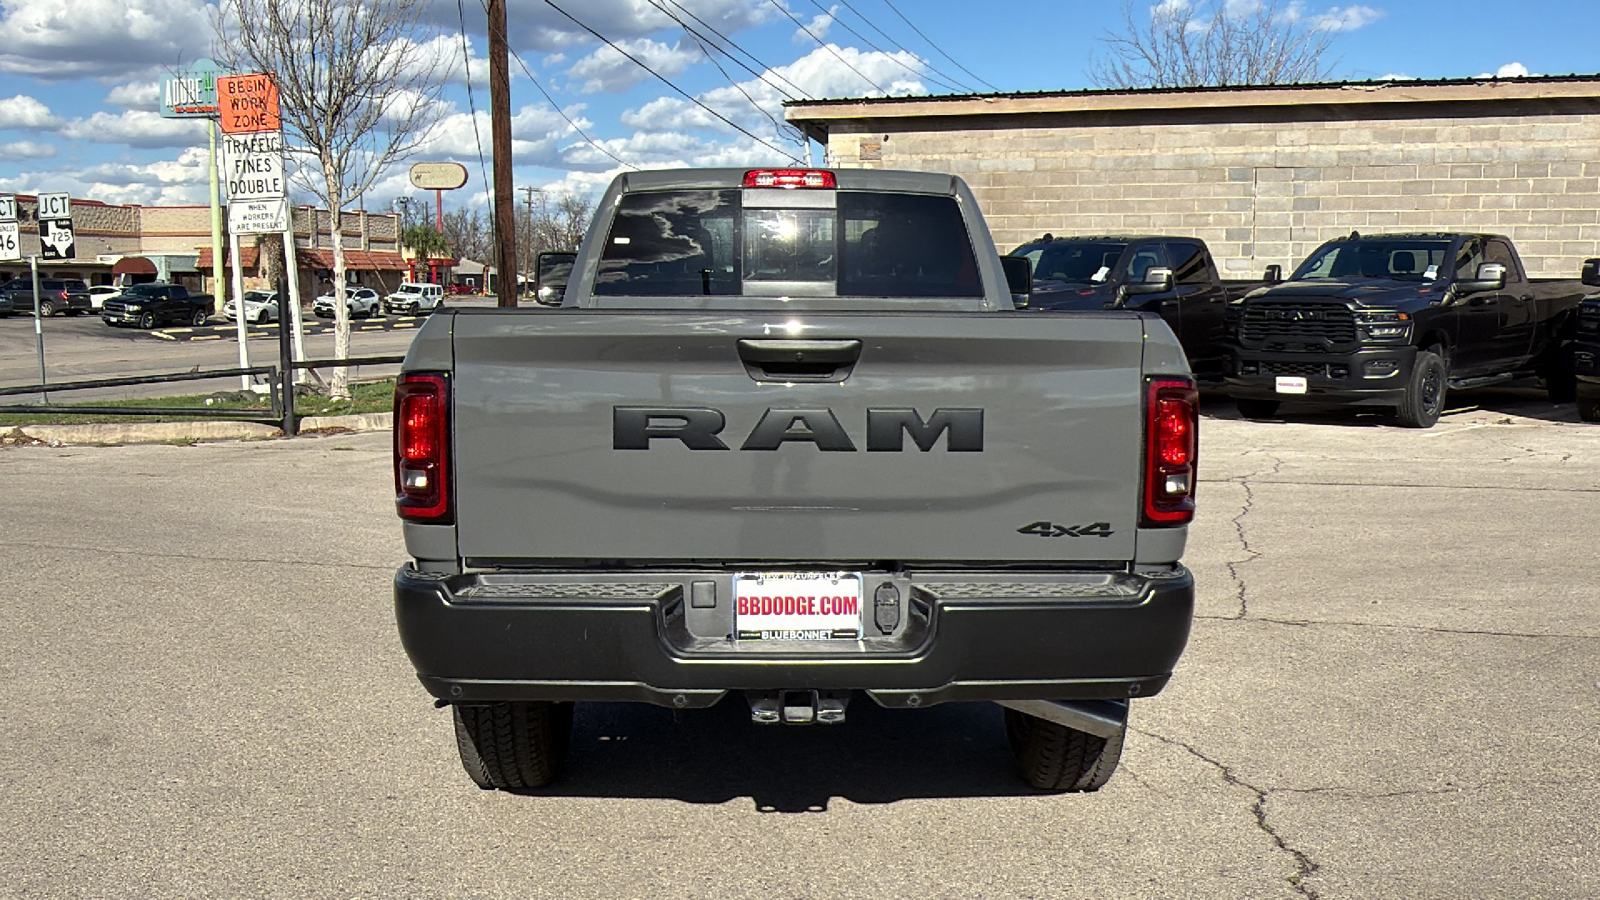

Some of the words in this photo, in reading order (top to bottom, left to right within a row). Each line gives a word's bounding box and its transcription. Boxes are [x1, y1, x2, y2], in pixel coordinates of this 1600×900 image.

[165, 78, 203, 106] ADOBE
[228, 79, 266, 94] BEGIN
[230, 96, 267, 110] WORK
[233, 113, 267, 128] ZONE
[225, 137, 279, 154] TRAFFIC
[235, 158, 272, 174] FINES
[230, 178, 280, 194] DOUBLE
[41, 196, 67, 215] JCT
[242, 212, 274, 221] WORKERS
[252, 221, 283, 230] PRESENT
[51, 231, 70, 242] 725
[613, 405, 984, 452] RAM
[738, 596, 857, 615] BBDODGE.COM
[761, 630, 833, 640] BLUEBONNET
